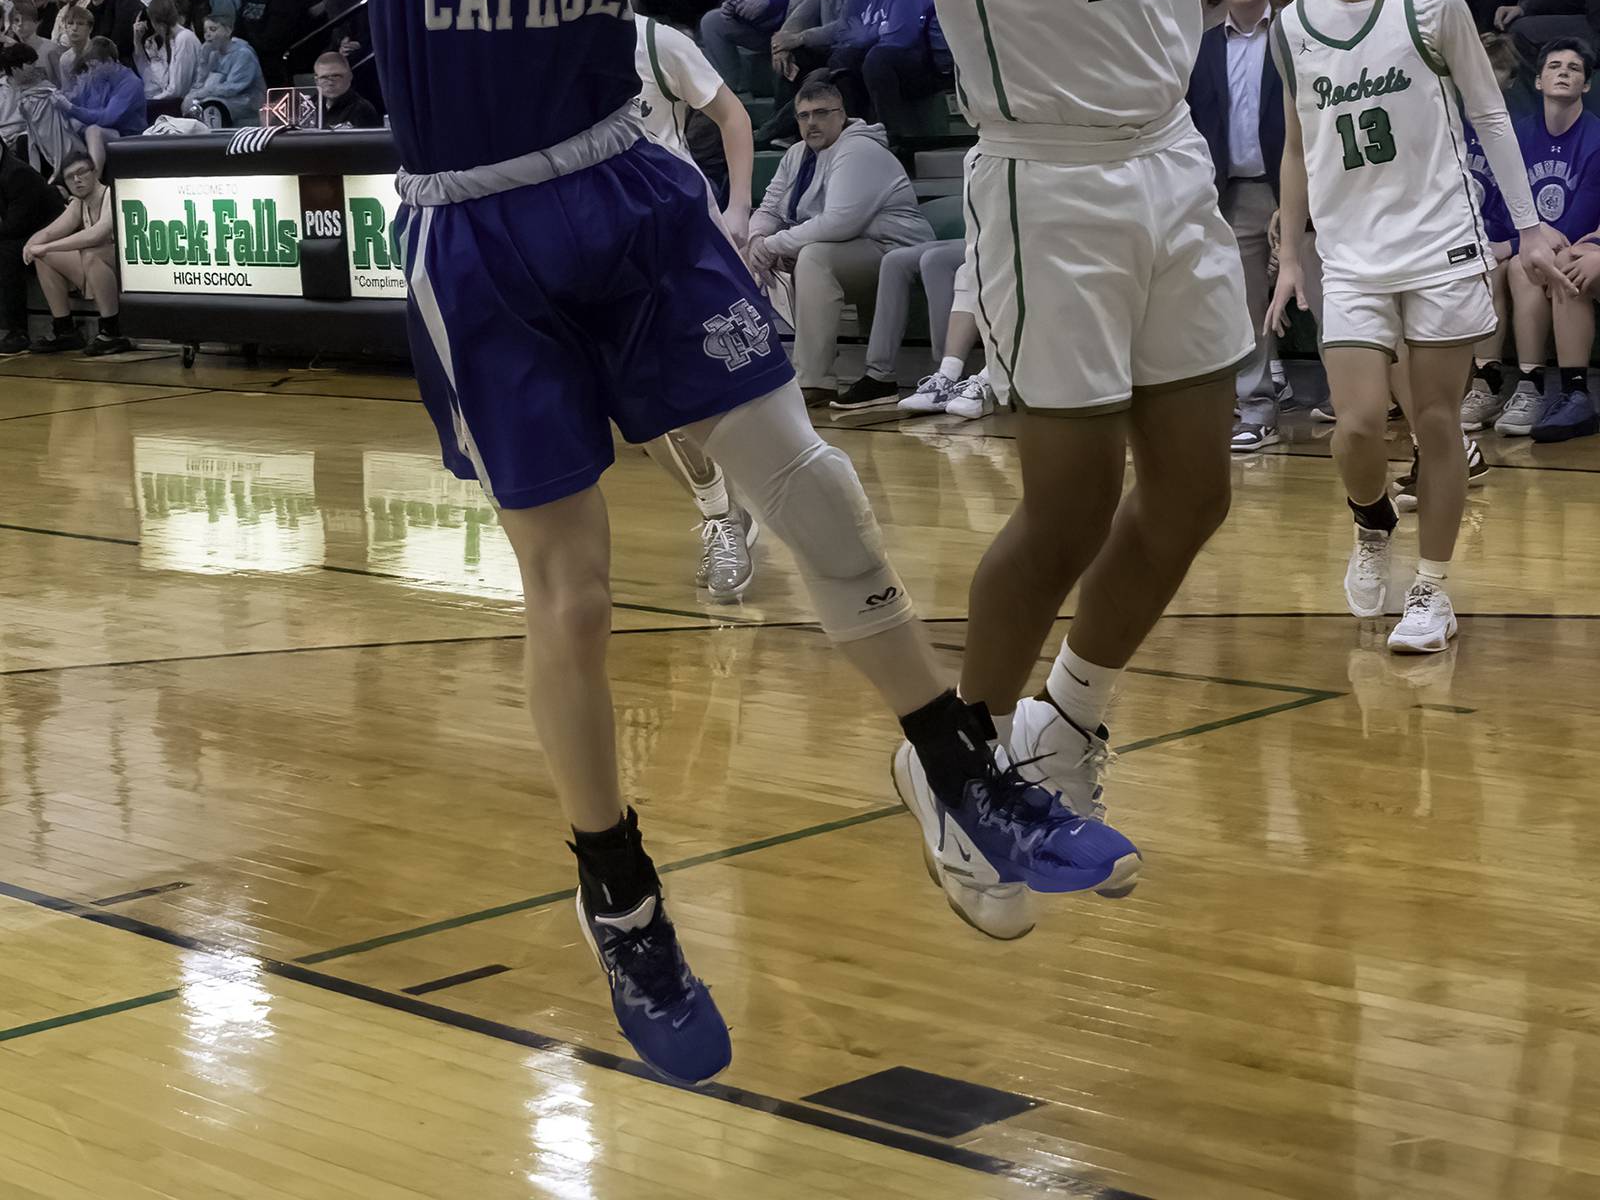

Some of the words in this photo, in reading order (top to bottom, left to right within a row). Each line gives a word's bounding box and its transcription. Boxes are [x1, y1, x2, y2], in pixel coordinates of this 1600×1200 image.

[1313, 66, 1412, 110] Rockets
[1336, 106, 1397, 171] 13
[121, 199, 211, 266] Rock
[213, 198, 299, 268] Falls
[305, 210, 342, 237] POSS
[174, 271, 201, 286] HIGH
[203, 272, 252, 287] SCHOOL
